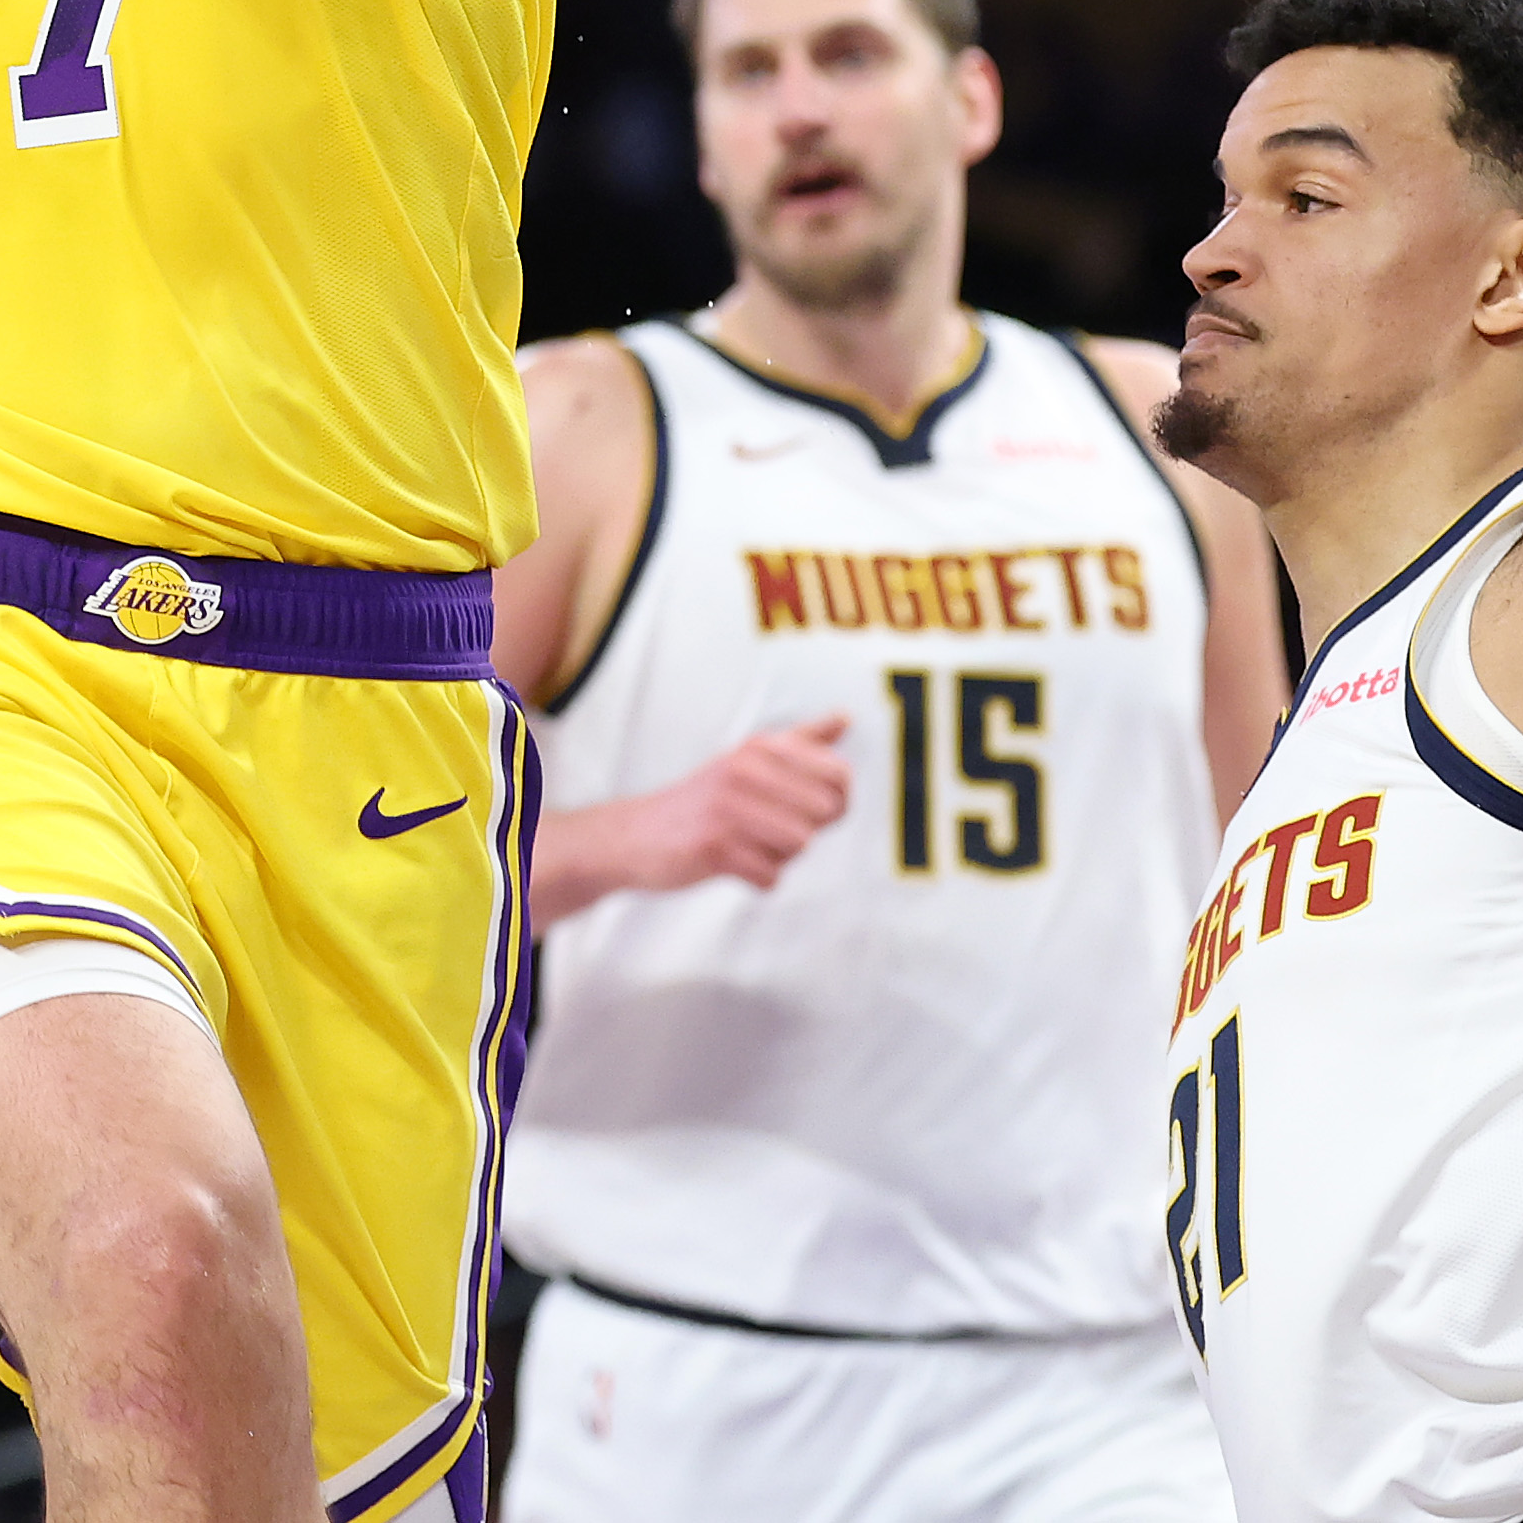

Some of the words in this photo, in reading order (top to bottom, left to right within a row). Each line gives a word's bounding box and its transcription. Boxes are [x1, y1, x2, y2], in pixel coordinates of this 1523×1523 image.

[93, 575, 224, 630] LAKERS
[138, 578, 160, 588] LOS
[161, 582, 218, 597] ANGELES
[743, 544, 1152, 634] NUGGETS
[885, 669, 1047, 875] 15
[1167, 1004, 1248, 1375] 21
